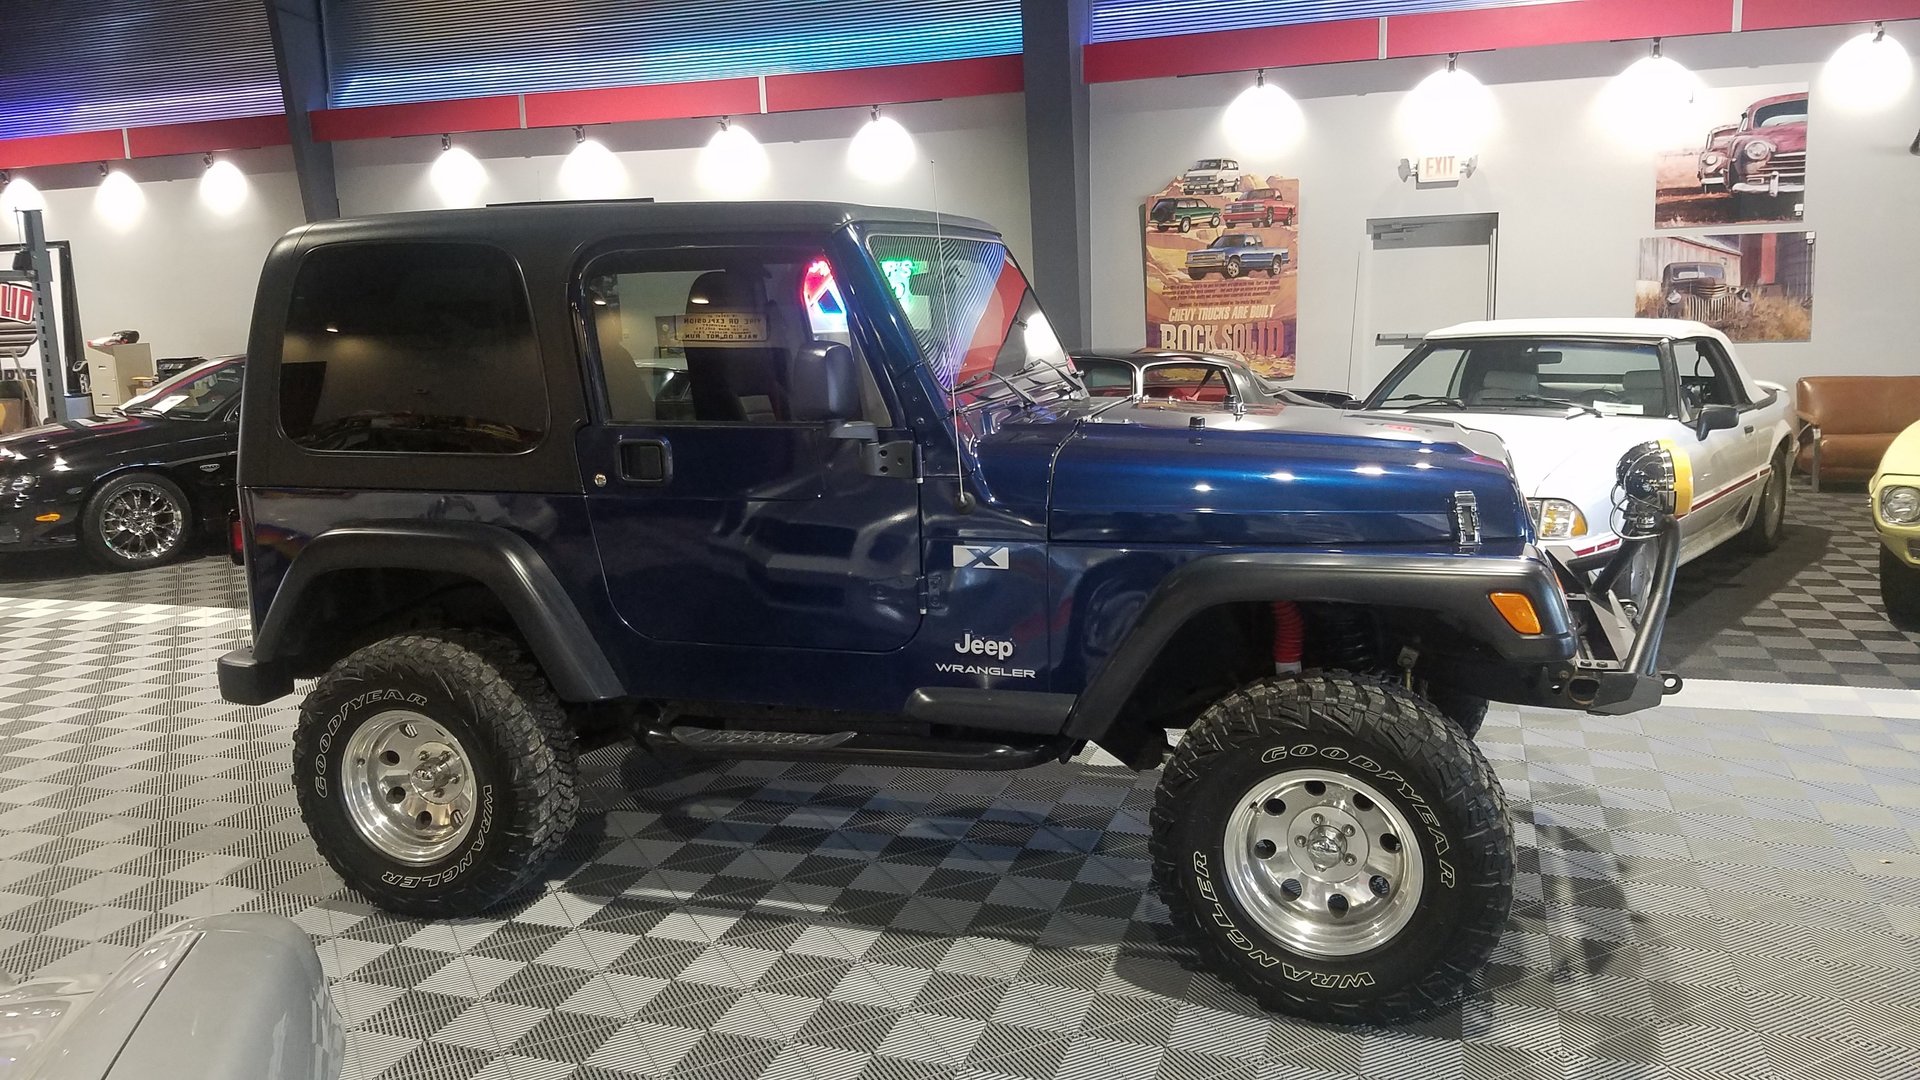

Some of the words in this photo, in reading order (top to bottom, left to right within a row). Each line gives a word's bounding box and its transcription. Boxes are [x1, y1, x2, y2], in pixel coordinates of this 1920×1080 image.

[1425, 156, 1455, 177] EXIT
[1168, 307, 1197, 322] CHEVY
[1198, 306, 1231, 320] TRUCKS
[1231, 305, 1250, 319] ARE
[1249, 304, 1276, 318] BUILT
[1160, 323, 1219, 353] ROCK
[1221, 320, 1285, 358] SOLID
[954, 633, 1013, 660] Jeep
[935, 663, 1036, 679] WRANGLER
[315, 689, 427, 798] GOODYEAR
[1262, 744, 1455, 889] GOODYEAR
[381, 785, 493, 889] WRANGLER
[1193, 851, 1375, 989] WRANGLER
